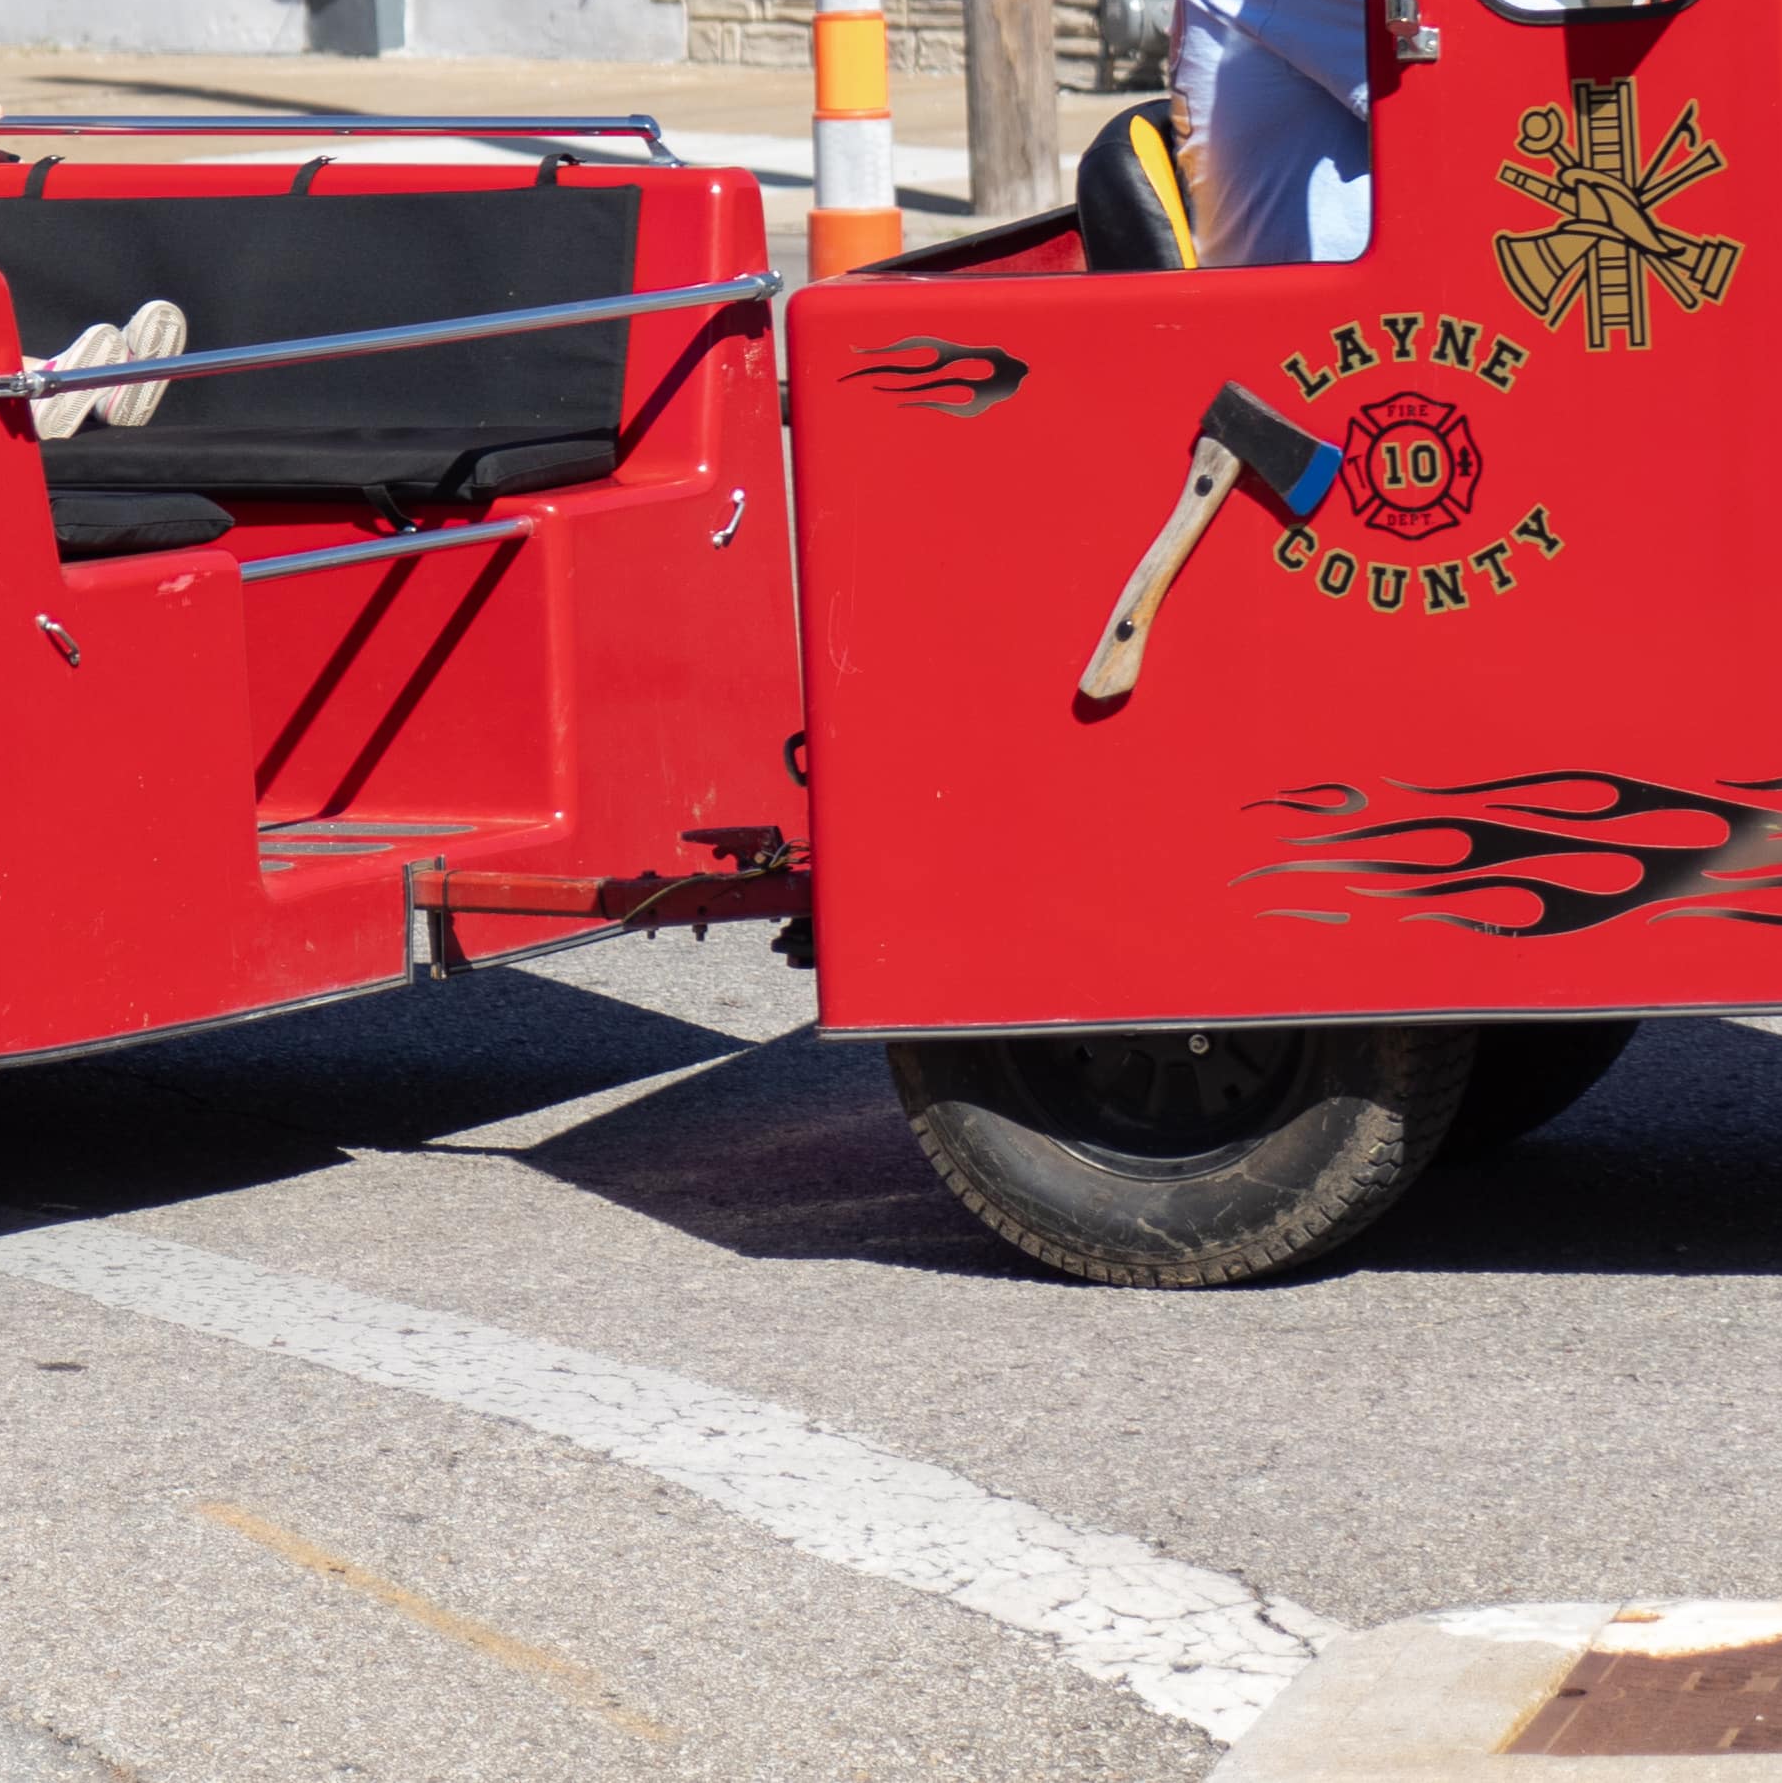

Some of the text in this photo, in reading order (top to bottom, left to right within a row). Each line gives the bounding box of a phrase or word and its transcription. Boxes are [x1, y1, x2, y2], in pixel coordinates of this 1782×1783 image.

[1281, 311, 1530, 403] LAYNE
[1387, 404, 1430, 417] FIRE
[1381, 440, 1442, 490] 10
[1387, 513, 1431, 526] DEPT
[1274, 502, 1565, 615] COUNTY
